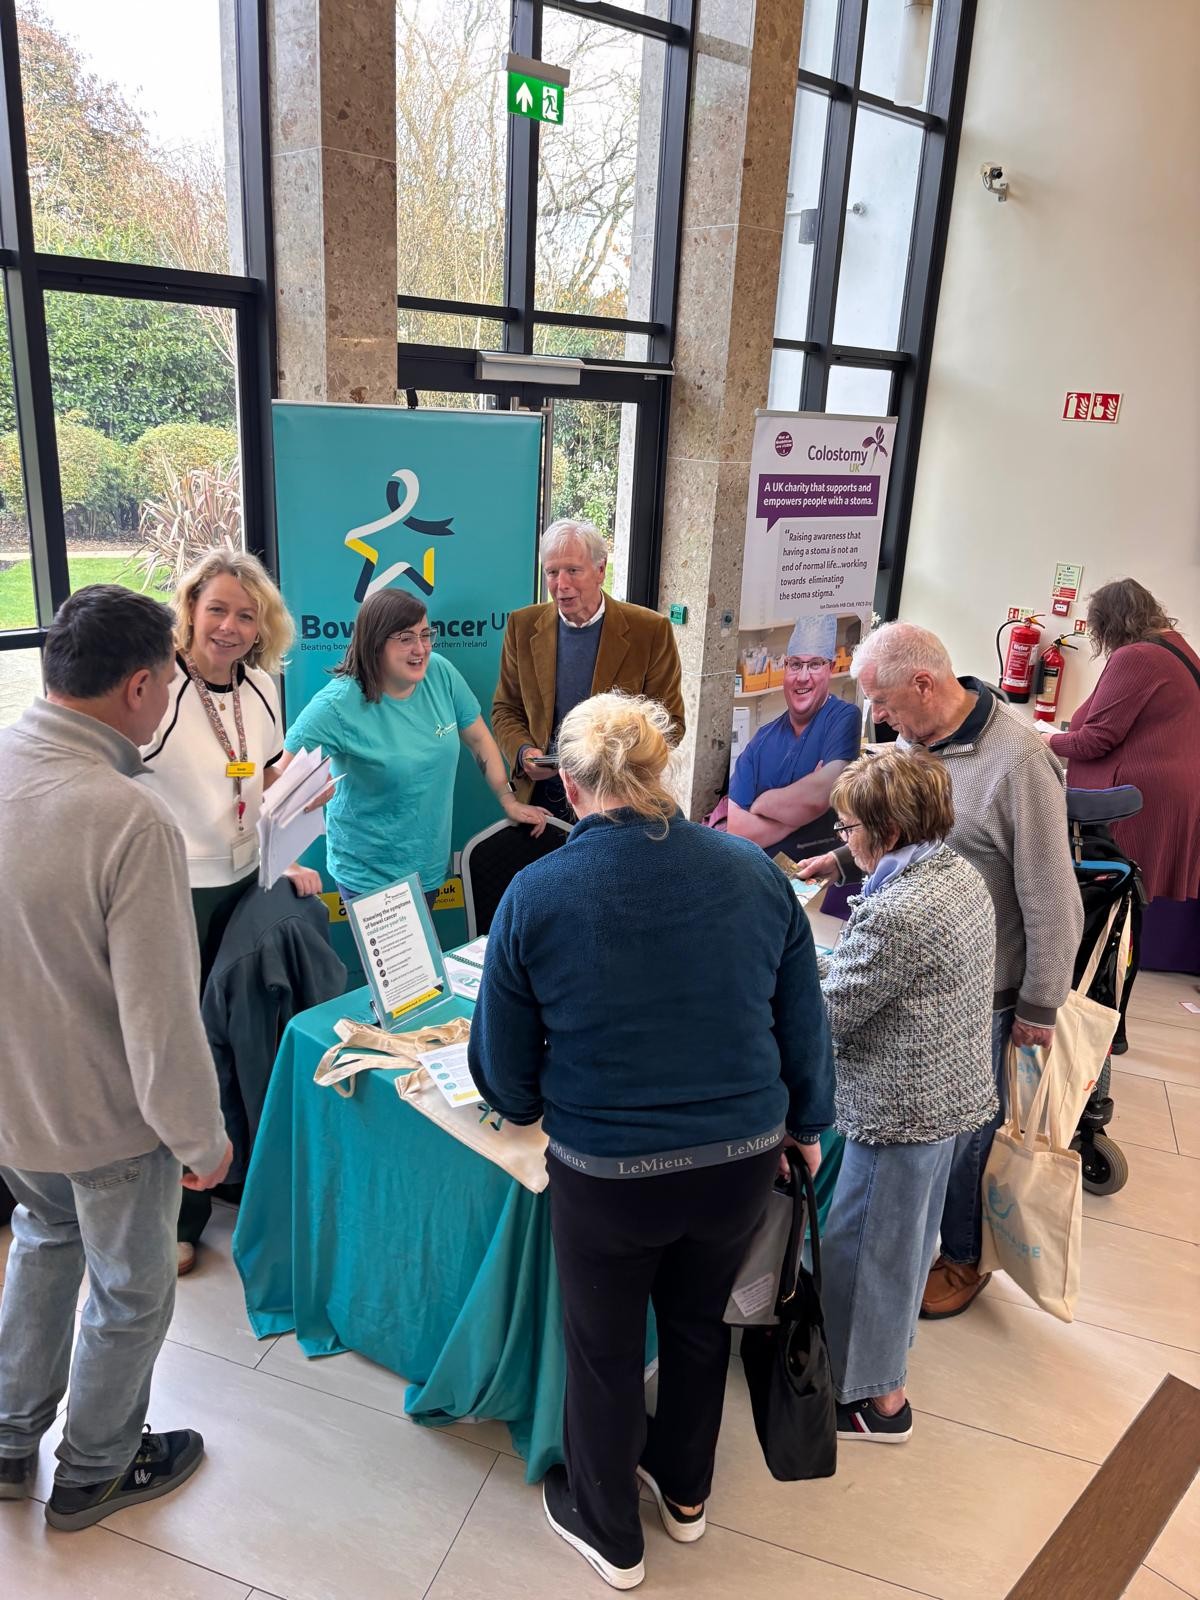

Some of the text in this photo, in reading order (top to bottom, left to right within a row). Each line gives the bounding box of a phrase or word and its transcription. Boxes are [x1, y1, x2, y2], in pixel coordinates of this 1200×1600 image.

[807, 445, 868, 465] Colostomy
[849, 463, 861, 472] UK
[764, 482, 872, 495] A UK charity that supports and
[763, 498, 802, 508] empowers
[802, 496, 827, 508] people
[828, 496, 843, 505] with
[850, 496, 873, 505] stoma.
[813, 532, 846, 541] awareness
[847, 531, 861, 540] that
[783, 547, 804, 557] having
[831, 546, 836, 554] is
[838, 546, 849, 554] not
[782, 563, 794, 571] end
[795, 562, 802, 571] of
[803, 561, 826, 570] normal
[780, 574, 844, 586] towards eliminating
[780, 592, 790, 600] the
[791, 592, 811, 600] stoma
[301, 612, 510, 639] Bow ncer U
[300, 643, 332, 651] Beating
[462, 640, 488, 648] Ireland
[384, 913, 398, 922] cancer
[618, 1156, 693, 1175] LeMieux
[726, 1132, 780, 1158] LeMieux
